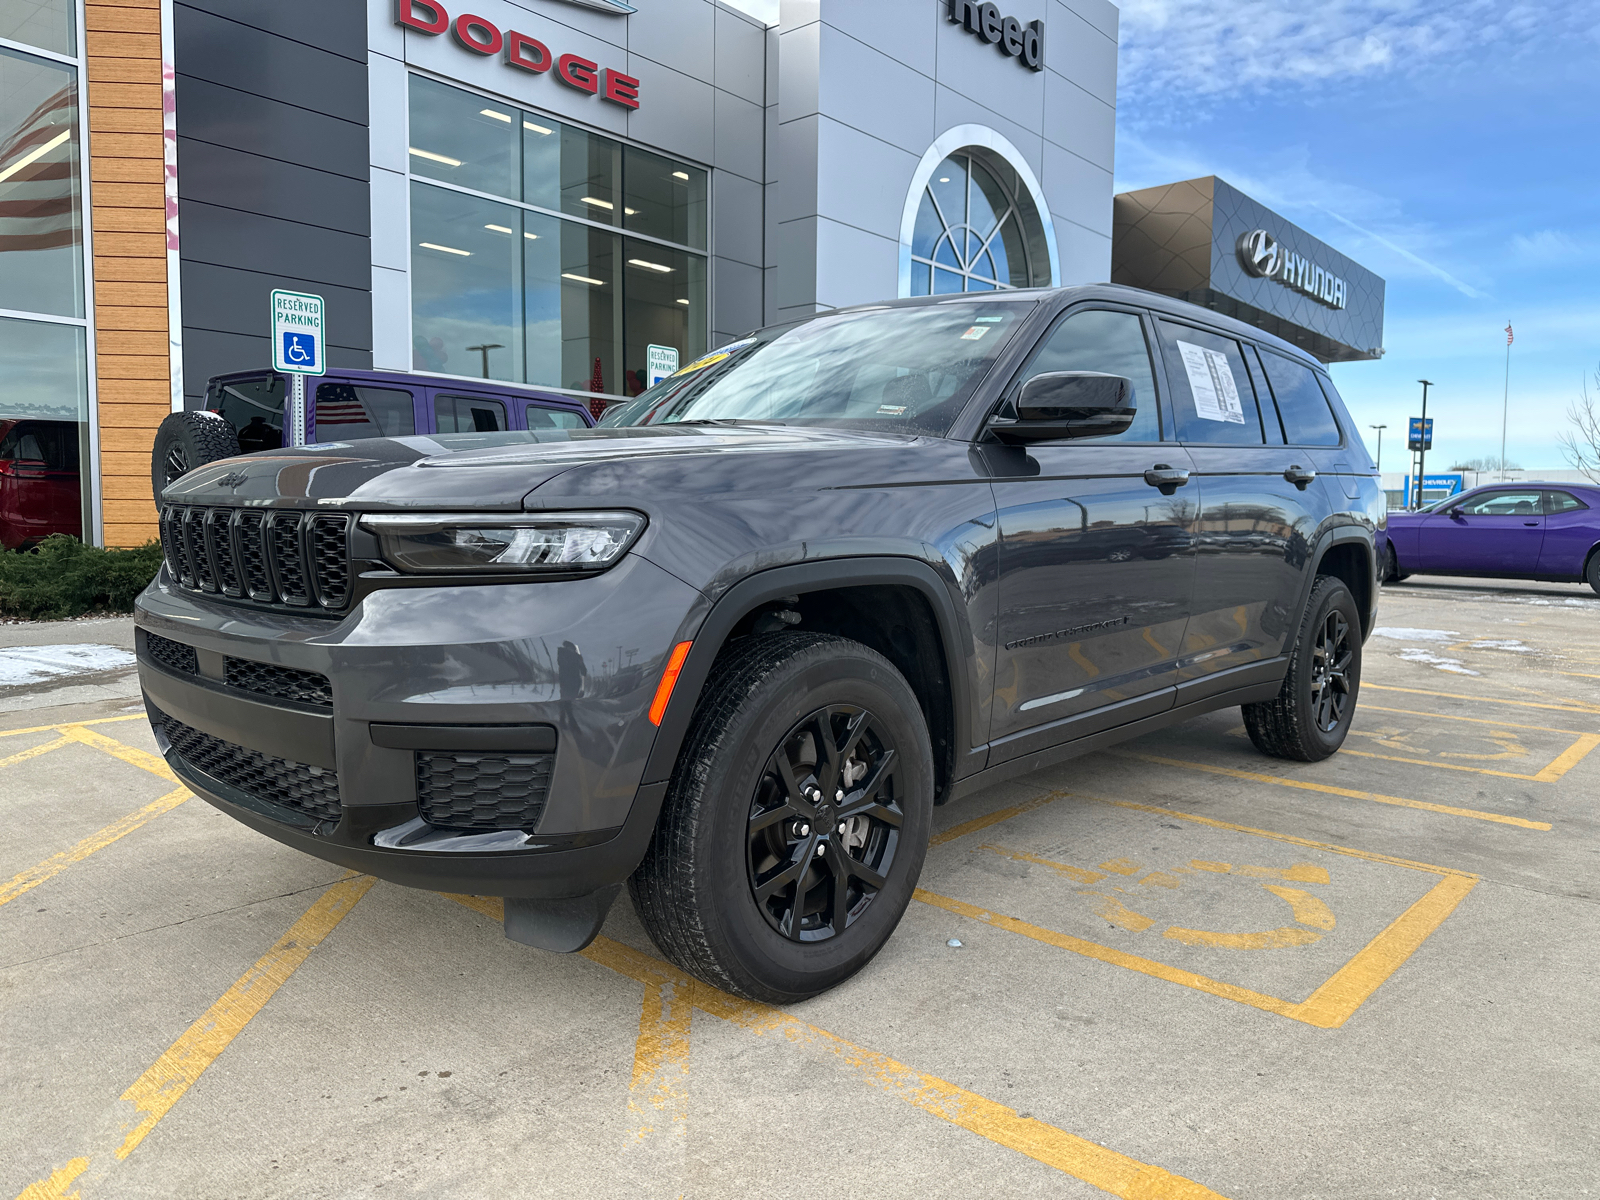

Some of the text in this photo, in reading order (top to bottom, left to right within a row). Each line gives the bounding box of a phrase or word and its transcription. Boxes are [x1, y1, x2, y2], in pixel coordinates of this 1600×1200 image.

[394, 0, 640, 111] DODGE
[1282, 248, 1347, 310] HYUNDAI
[277, 298, 319, 314] RESERVED
[277, 312, 320, 328] PARKING
[650, 351, 676, 363] RESERVED
[650, 361, 676, 373] PARKING
